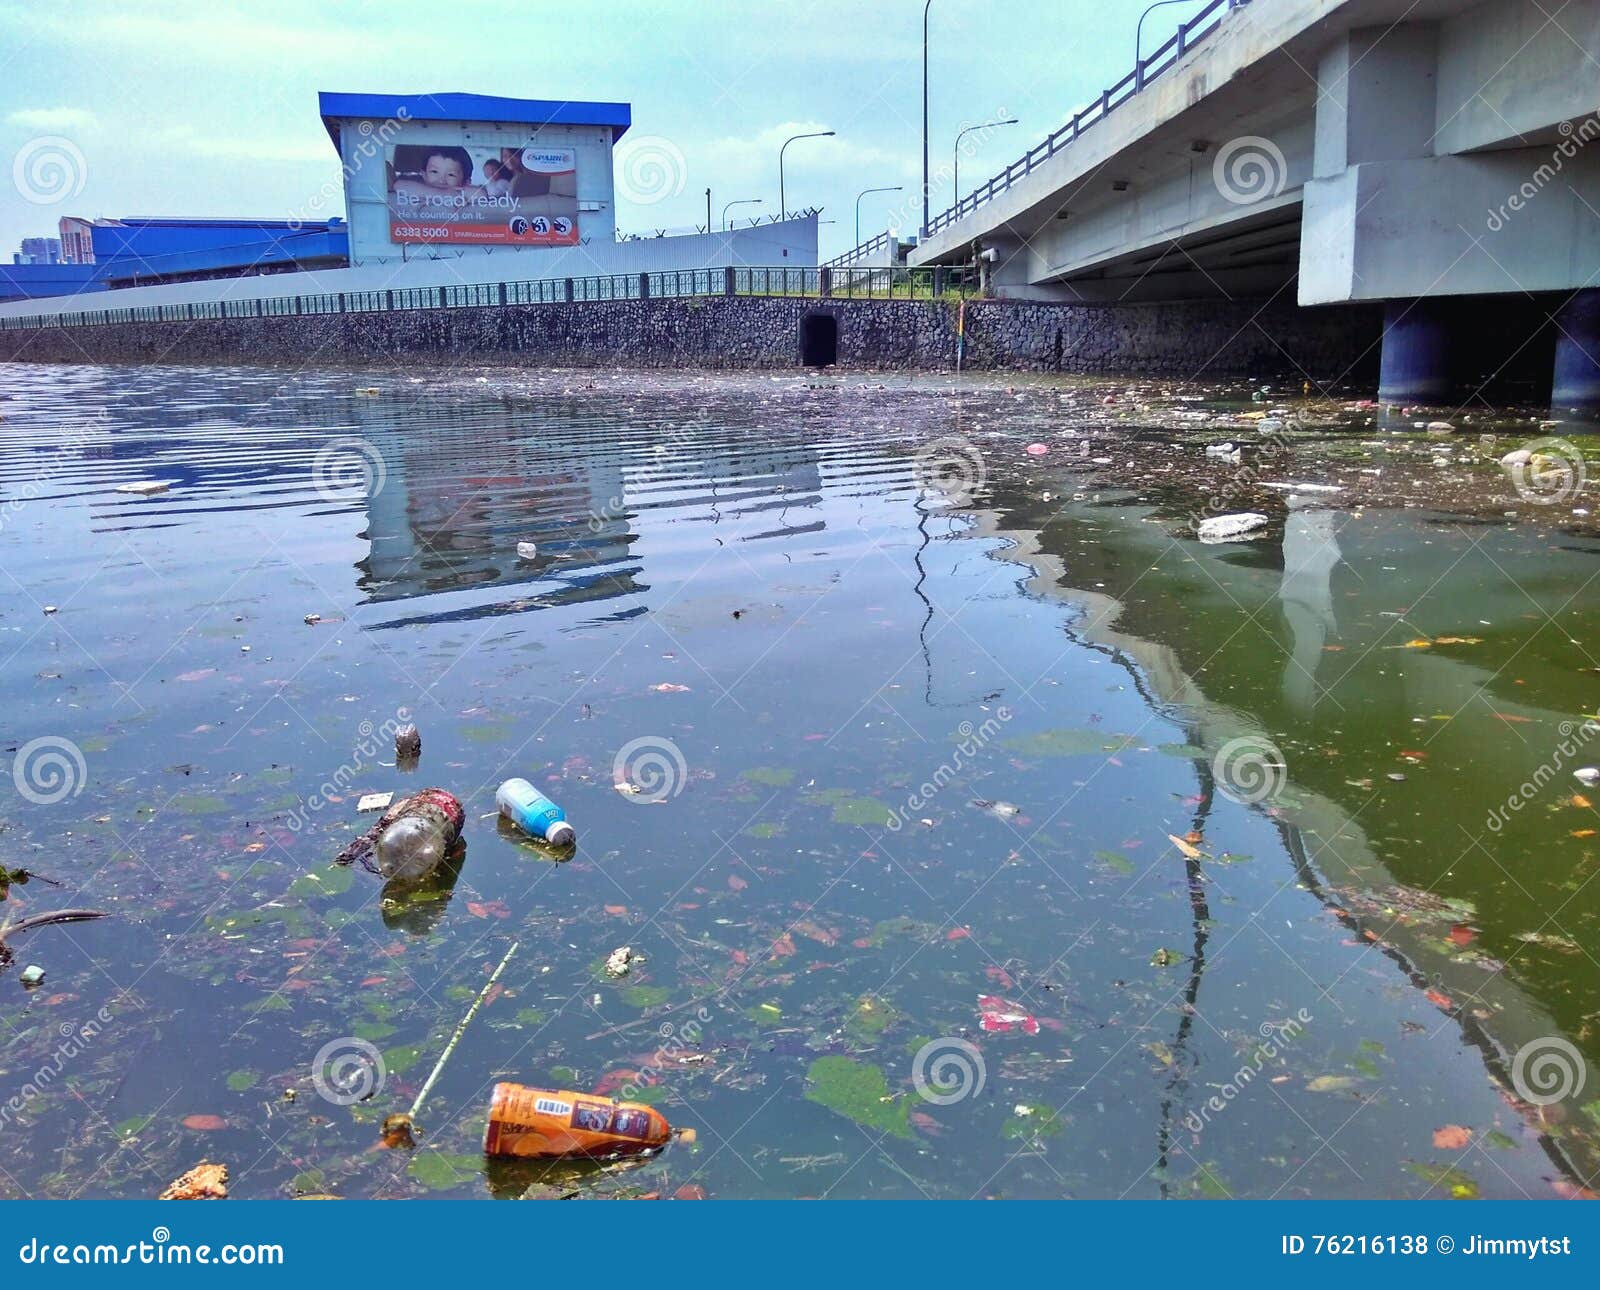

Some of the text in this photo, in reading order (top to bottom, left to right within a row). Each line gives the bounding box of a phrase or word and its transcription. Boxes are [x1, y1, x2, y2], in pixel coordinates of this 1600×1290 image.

[396, 190, 521, 212] Be road ready.
[399, 210, 418, 219] He's
[419, 211, 459, 221] counting
[462, 212, 473, 220] on
[395, 227, 449, 237] 6383 5000
